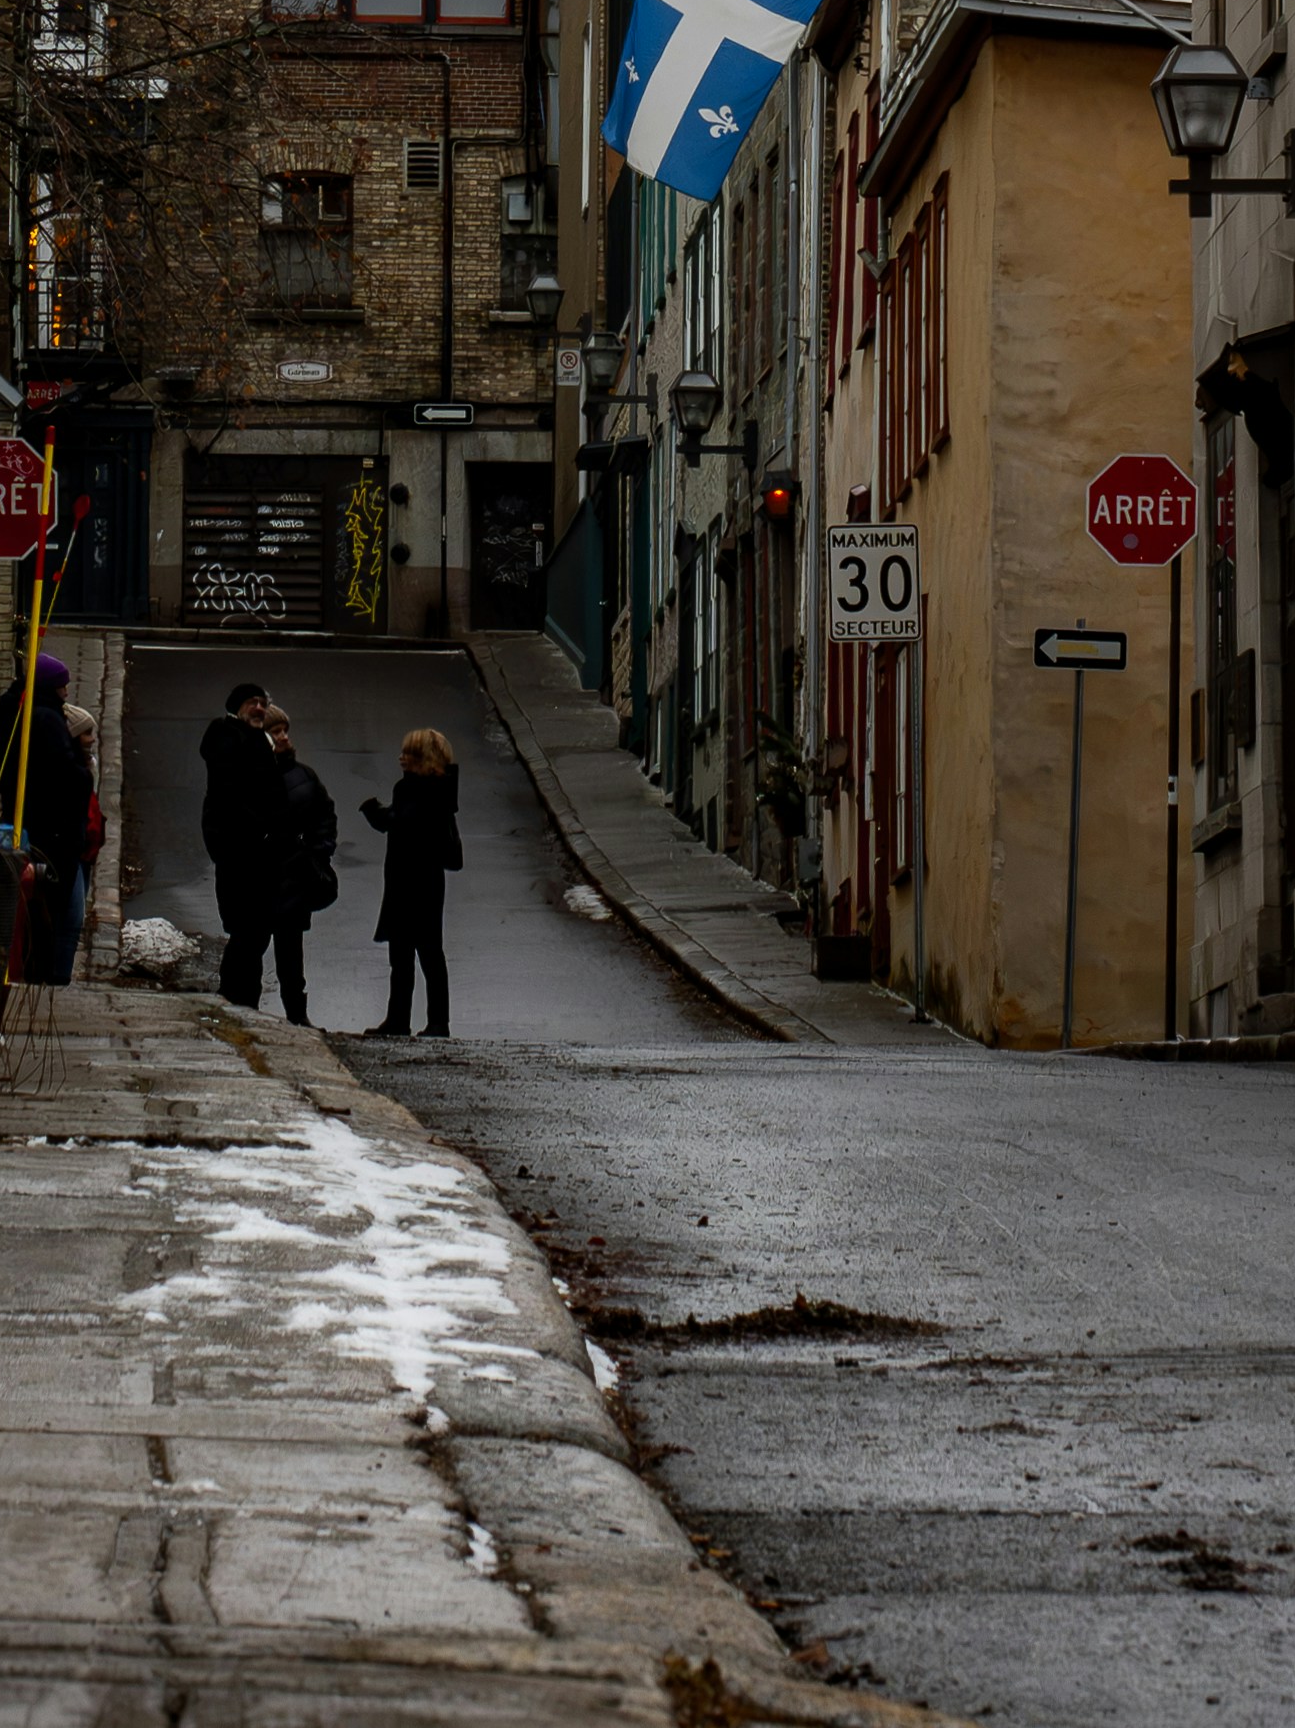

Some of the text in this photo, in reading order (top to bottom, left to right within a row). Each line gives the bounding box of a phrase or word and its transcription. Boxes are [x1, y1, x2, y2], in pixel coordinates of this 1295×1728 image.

[1093, 488, 1192, 526] ARRÊT
[832, 533, 915, 548] MAXIMUM
[837, 555, 912, 613] 30
[834, 620, 916, 636] SECTEUR
